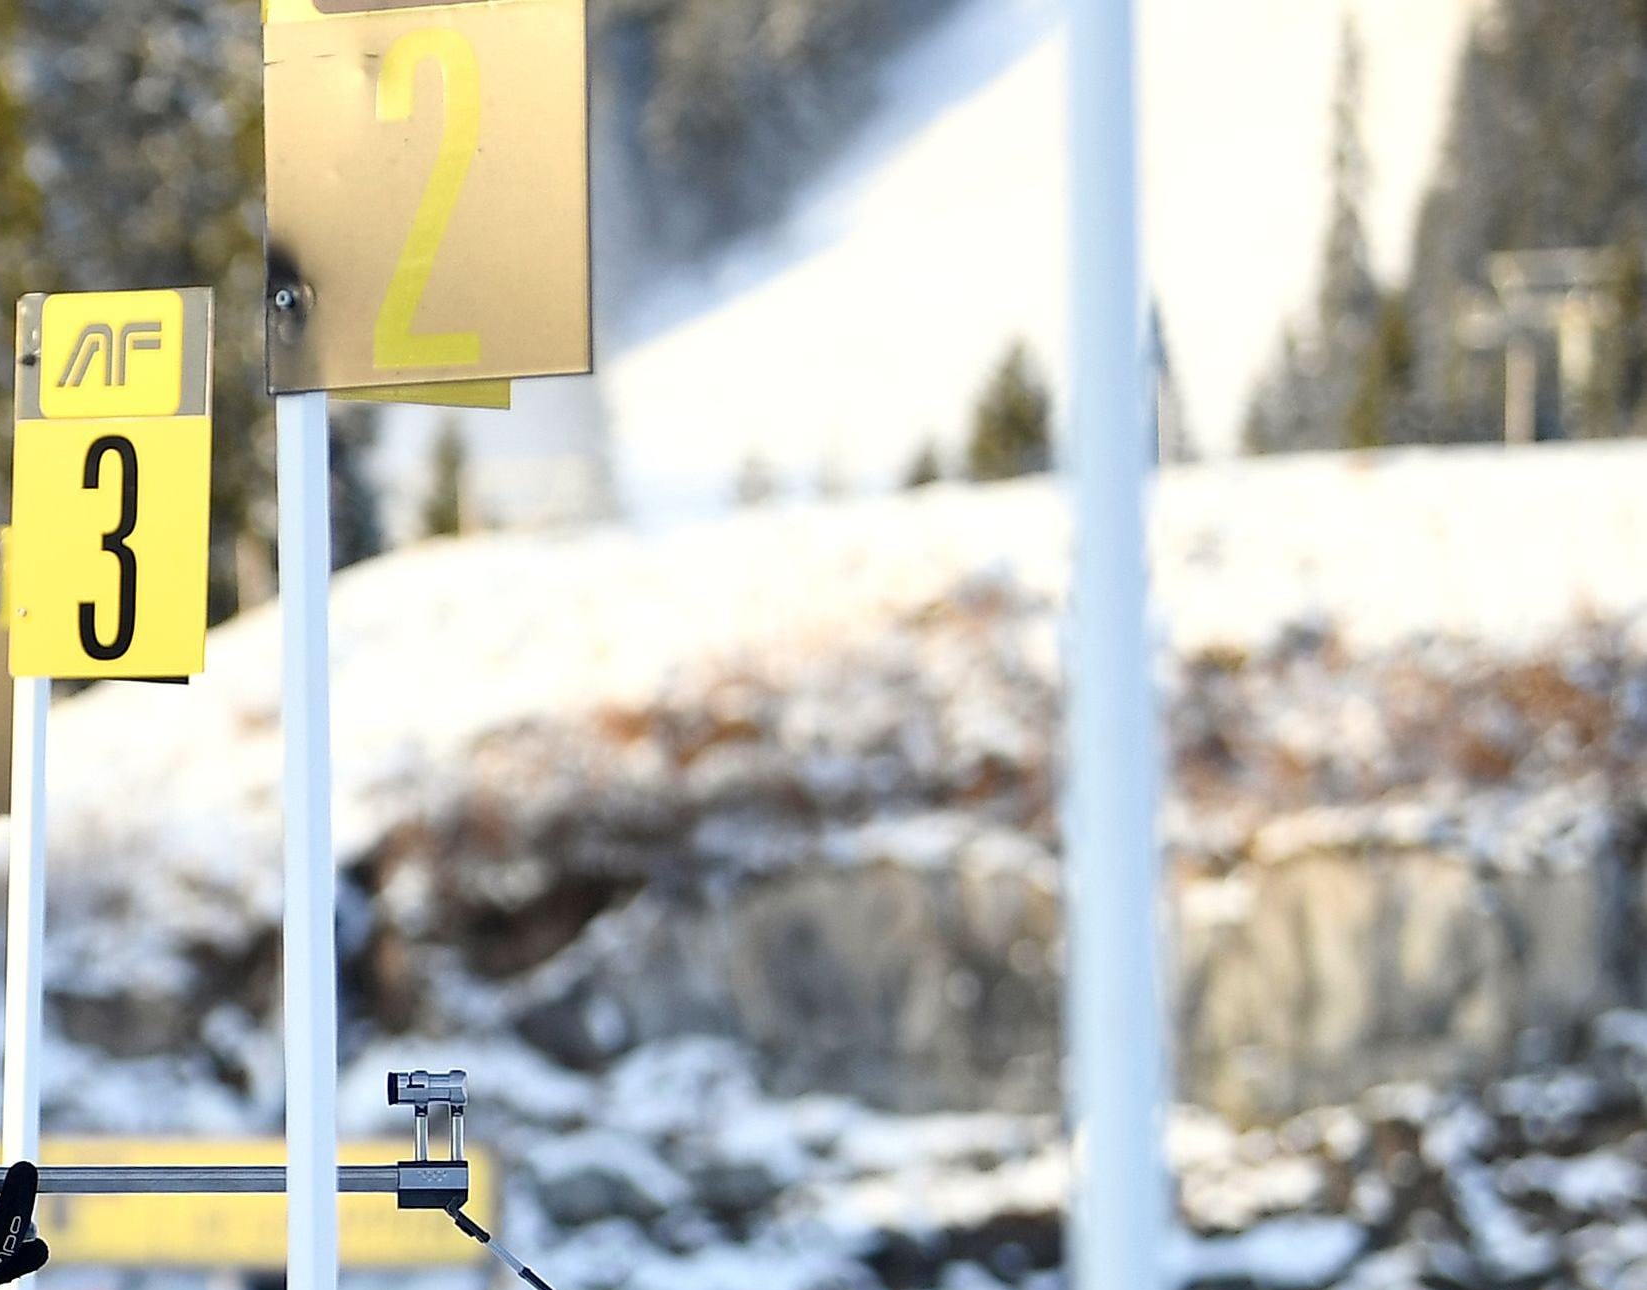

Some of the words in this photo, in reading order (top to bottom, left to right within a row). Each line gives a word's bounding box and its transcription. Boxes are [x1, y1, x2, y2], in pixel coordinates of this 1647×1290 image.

[372, 26, 482, 370] 2
[56, 321, 163, 388] AF
[78, 434, 139, 662] 3
